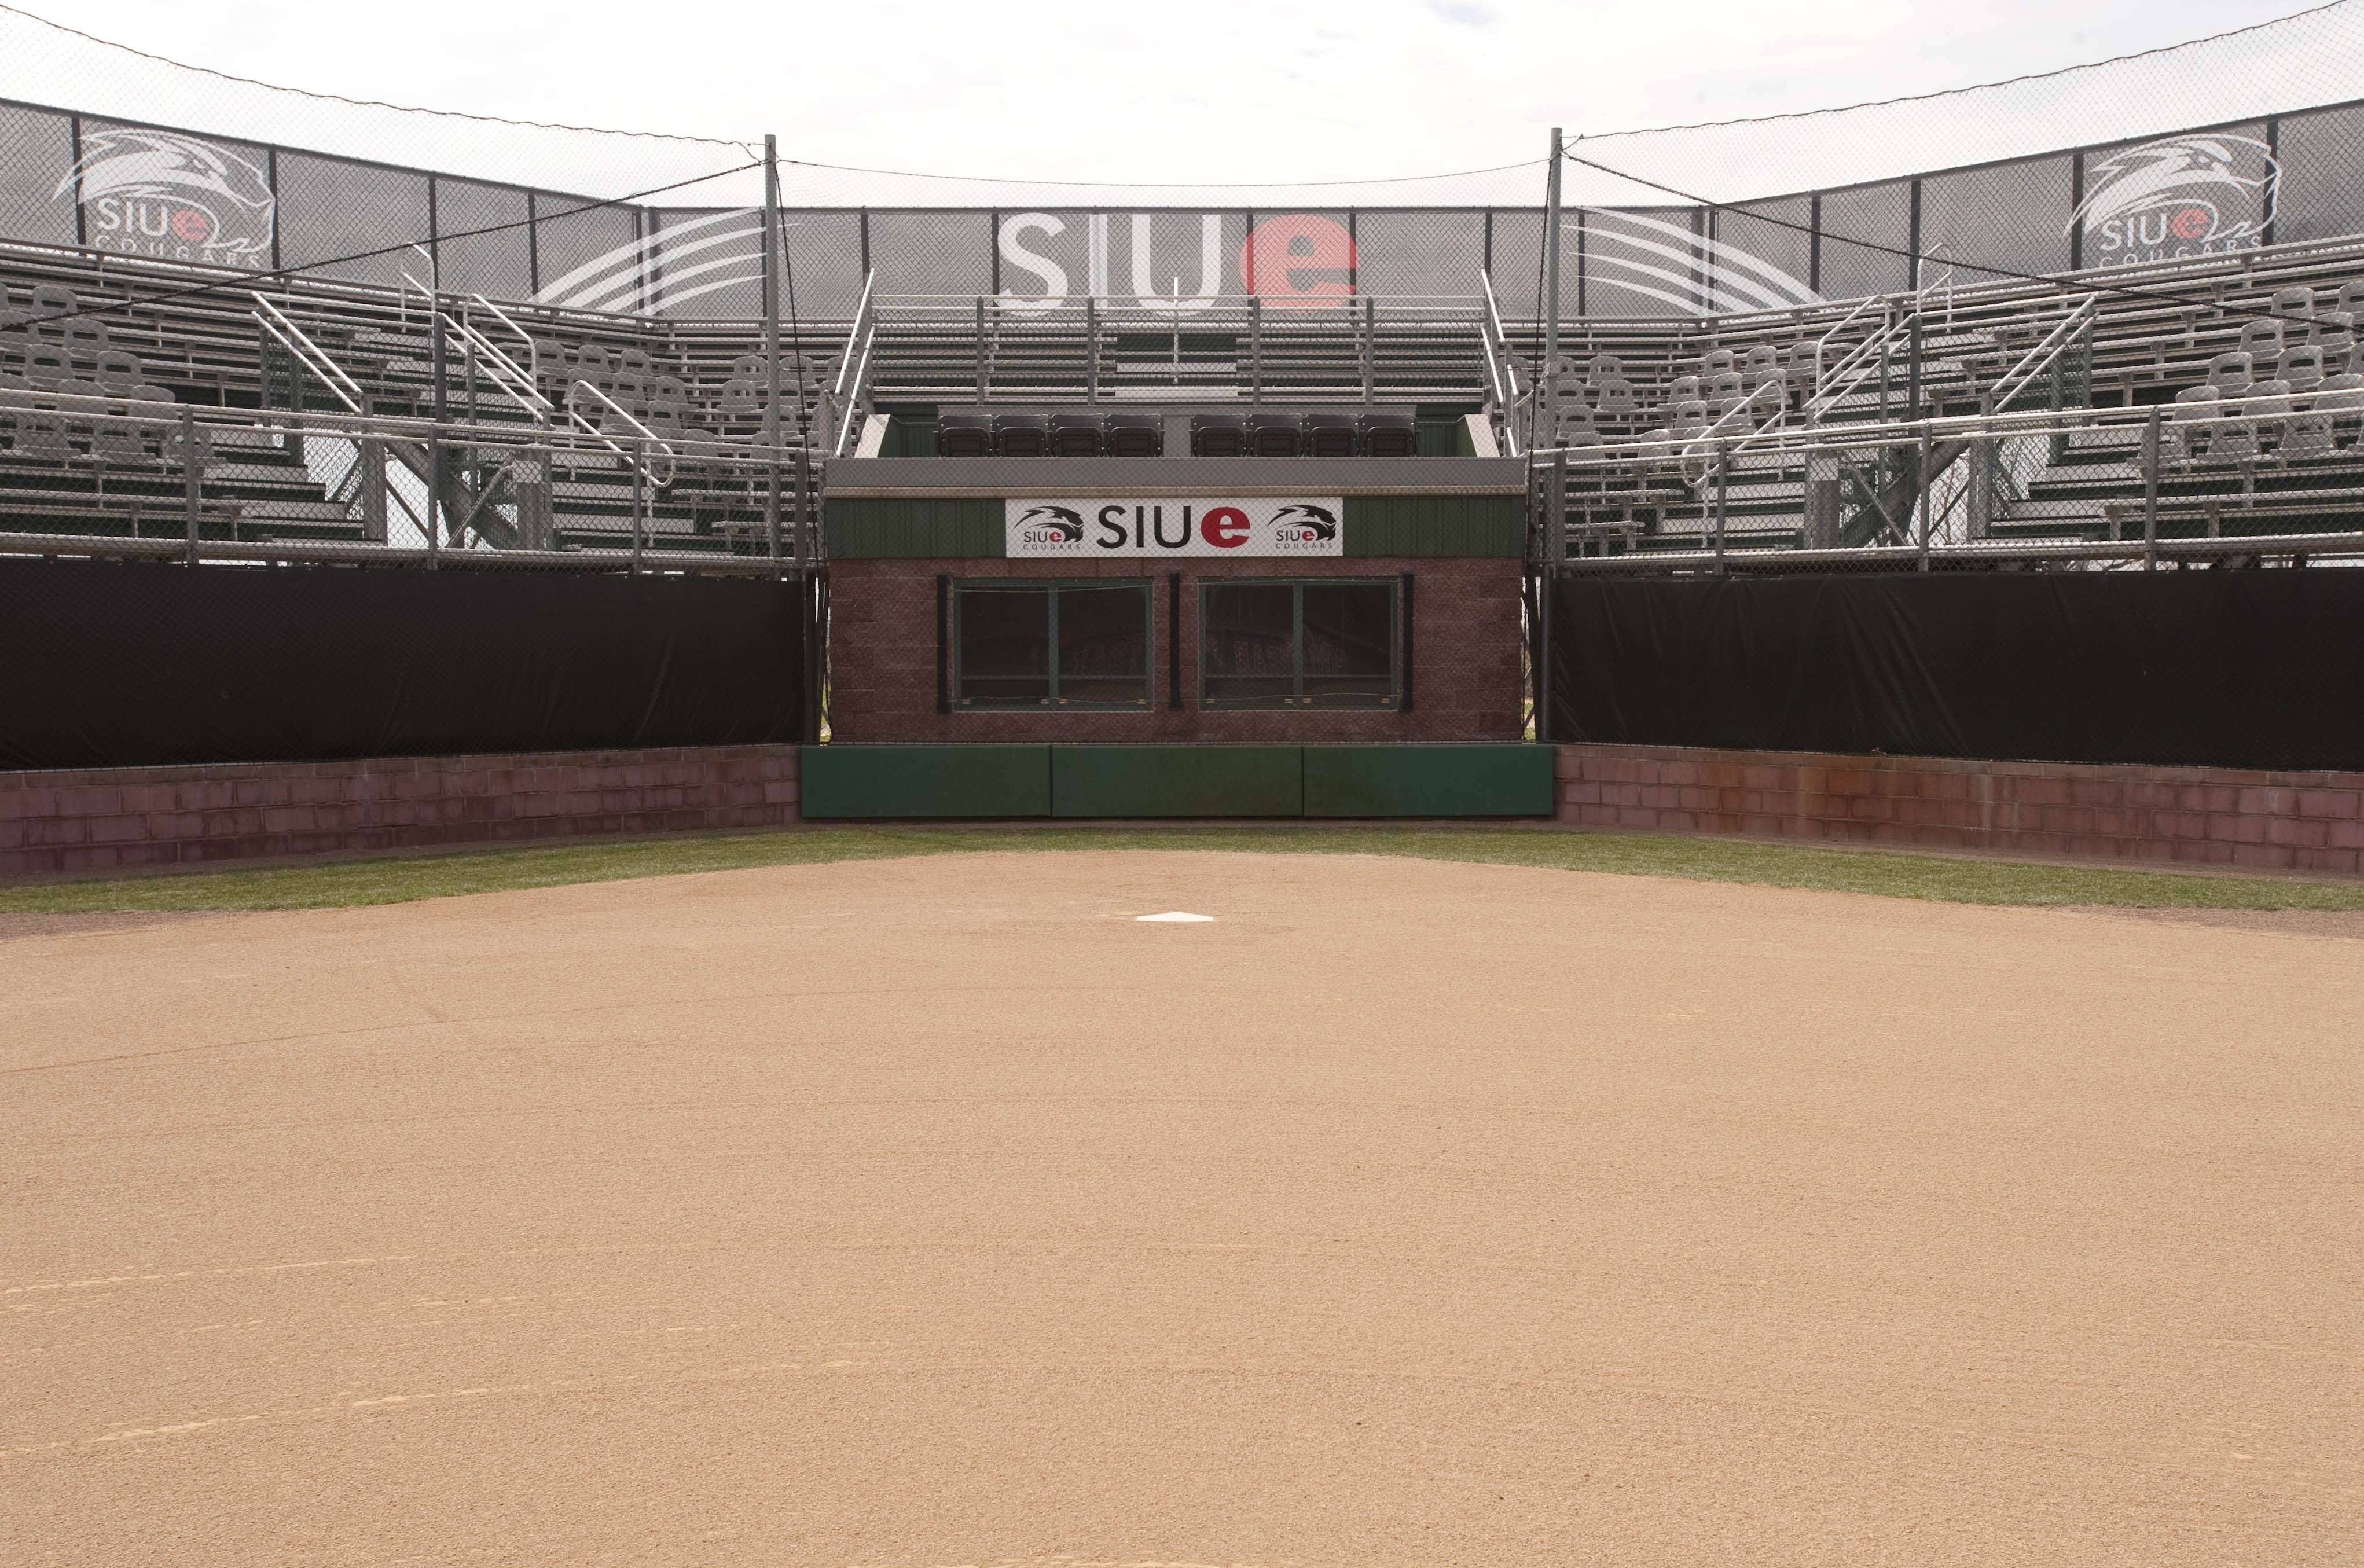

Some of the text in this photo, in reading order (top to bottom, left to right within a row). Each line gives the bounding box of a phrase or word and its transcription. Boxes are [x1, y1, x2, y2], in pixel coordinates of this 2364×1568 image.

[97, 197, 207, 241] SIUe
[2100, 208, 2209, 251] SIUe
[95, 234, 260, 268] COUGARS
[993, 212, 1359, 317] SIUe
[1023, 531, 1062, 542] SIUe
[1096, 505, 1251, 549] SIUe
[1276, 530, 1315, 541] SIUe
